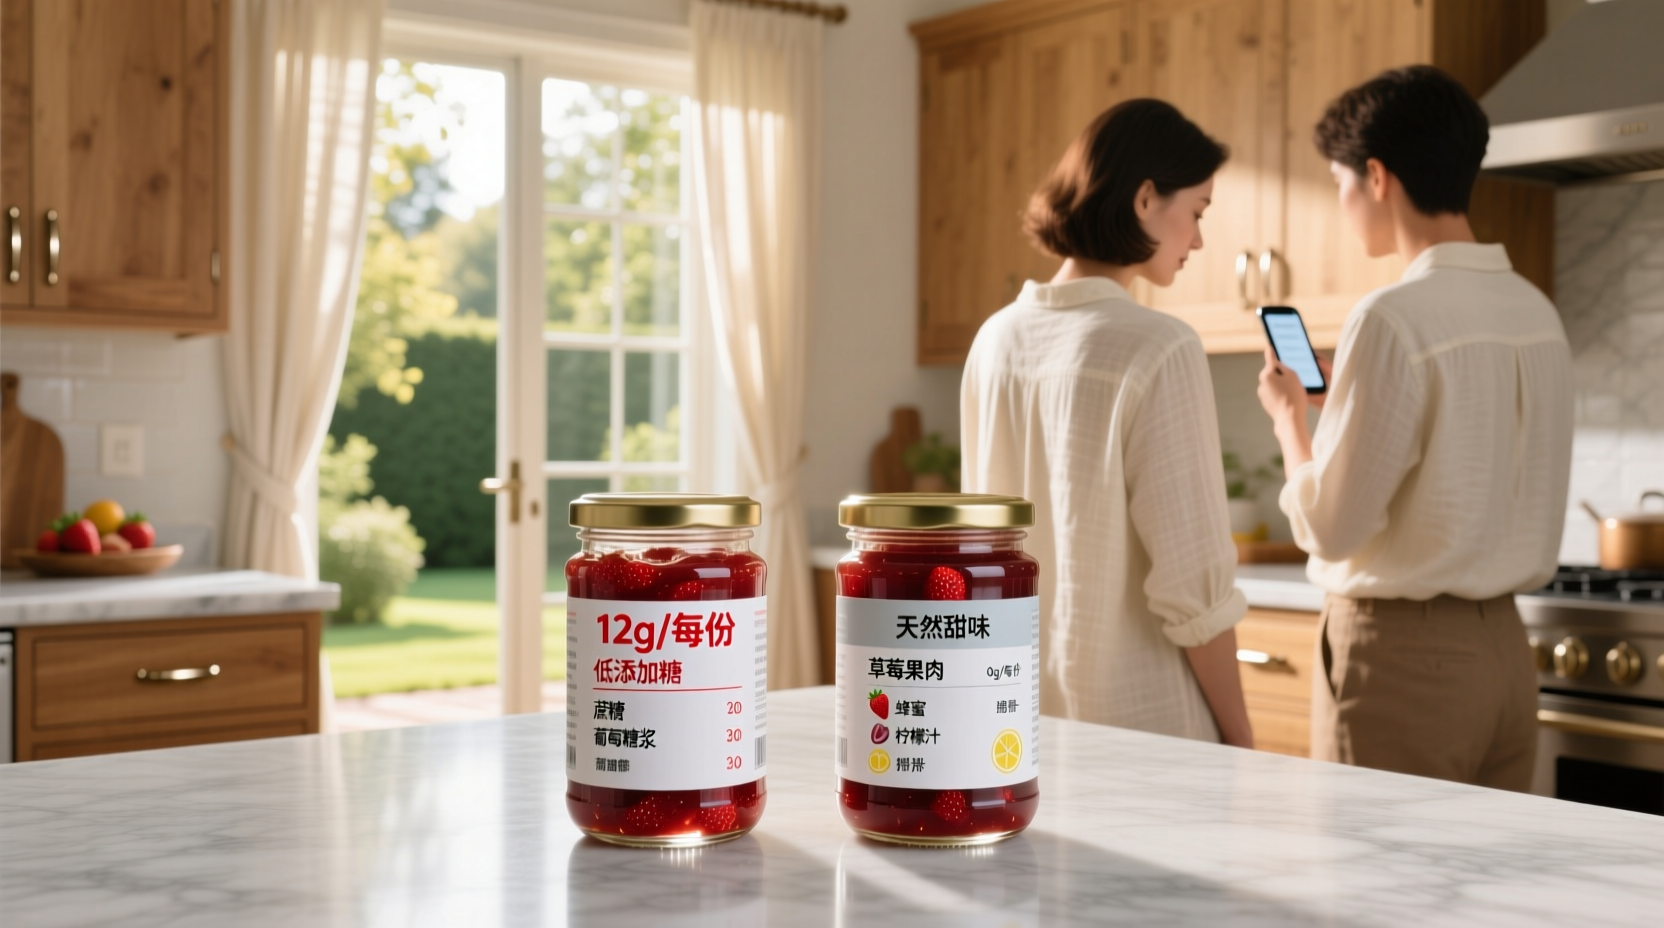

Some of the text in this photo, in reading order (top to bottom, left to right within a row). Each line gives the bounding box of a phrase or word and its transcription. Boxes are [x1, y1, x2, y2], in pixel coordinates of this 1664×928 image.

[597, 611, 735, 654] 12g/每份
[896, 614, 990, 639] 天然甜味
[593, 658, 682, 684] 低添加糖
[868, 657, 944, 681] 草莓果肉
[726, 701, 742, 714] 20
[895, 727, 941, 745] 柠檬汁
